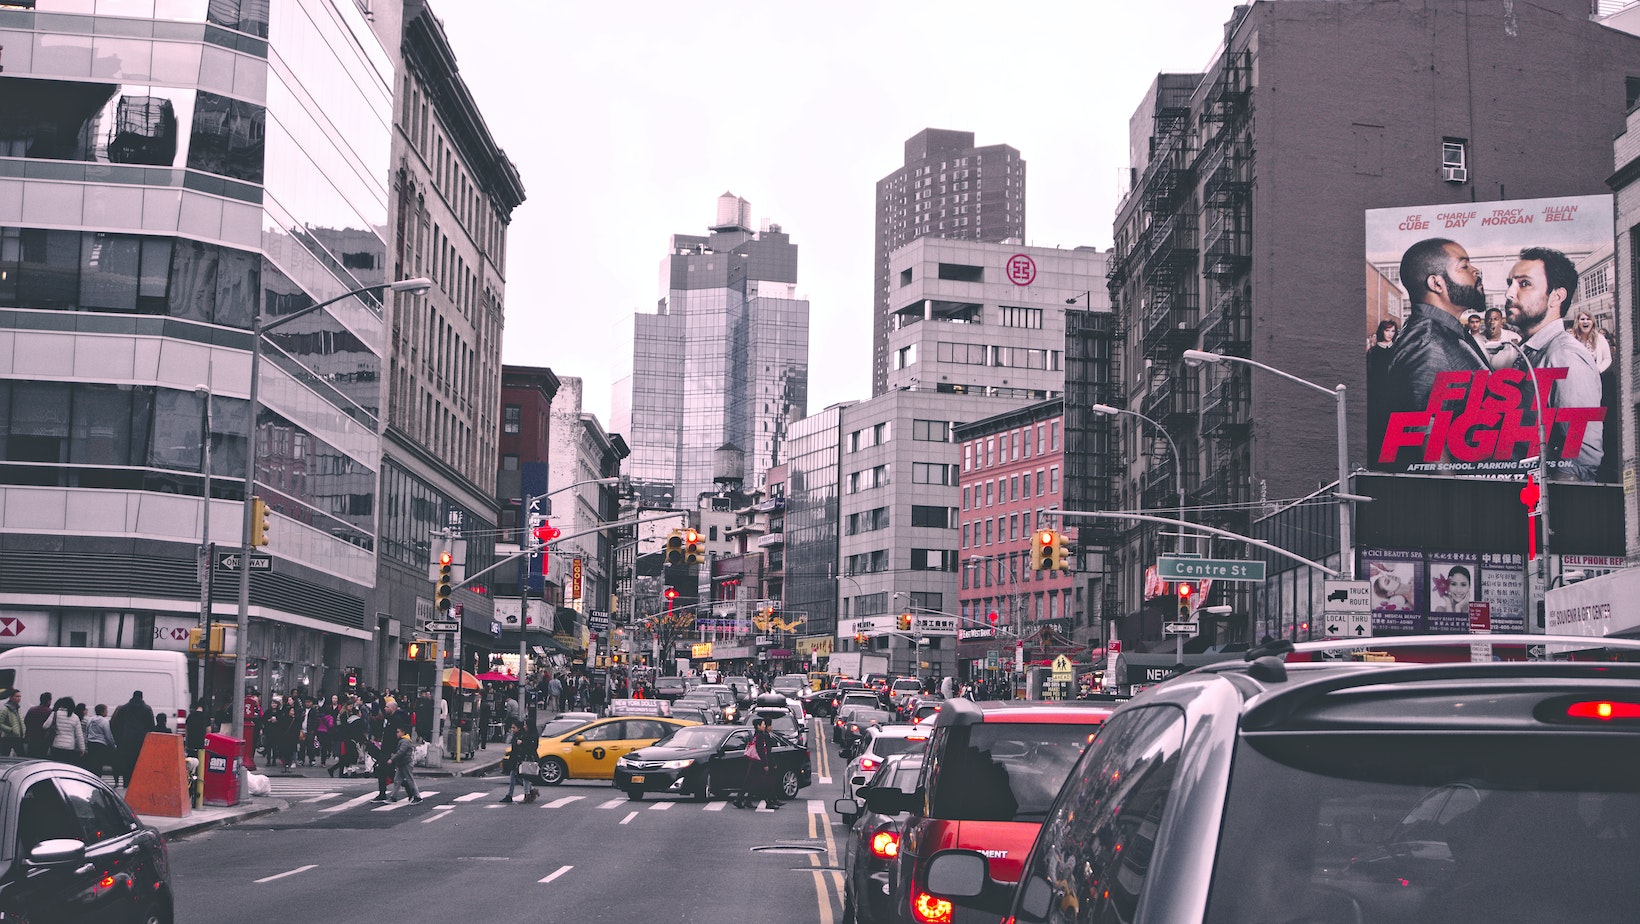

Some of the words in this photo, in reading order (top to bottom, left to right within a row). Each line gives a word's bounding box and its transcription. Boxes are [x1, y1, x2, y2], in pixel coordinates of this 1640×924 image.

[1492, 208, 1523, 217] TRACY
[1542, 205, 1578, 214] JILLIAN
[1406, 214, 1422, 223] ICE
[1436, 211, 1477, 220] CHARLIE
[1482, 214, 1534, 226] MORGAN
[1544, 212, 1574, 222] BELL
[1398, 221, 1430, 231] CUBE
[1444, 218, 1470, 228] DAY
[1426, 367, 1570, 413] FIST
[1378, 407, 1608, 463] FIGHT
[1407, 464, 1436, 472] AFTER
[1477, 462, 1518, 470] PARKING
[1518, 461, 1538, 469] LOT.
[1558, 460, 1574, 468] ON.
[1384, 550, 1410, 558] BEAUTY
[1482, 553, 1522, 564] 中華保險
[226, 558, 240, 566] ONE
[1564, 556, 1582, 564] CELL
[1583, 556, 1608, 565] PHONE
[1610, 557, 1625, 566] REP
[1176, 562, 1227, 576] Centre
[1231, 565, 1247, 576] St
[1350, 598, 1369, 606] ROUTE
[1592, 603, 1612, 620] CENTER
[210, 758, 226, 768] am
